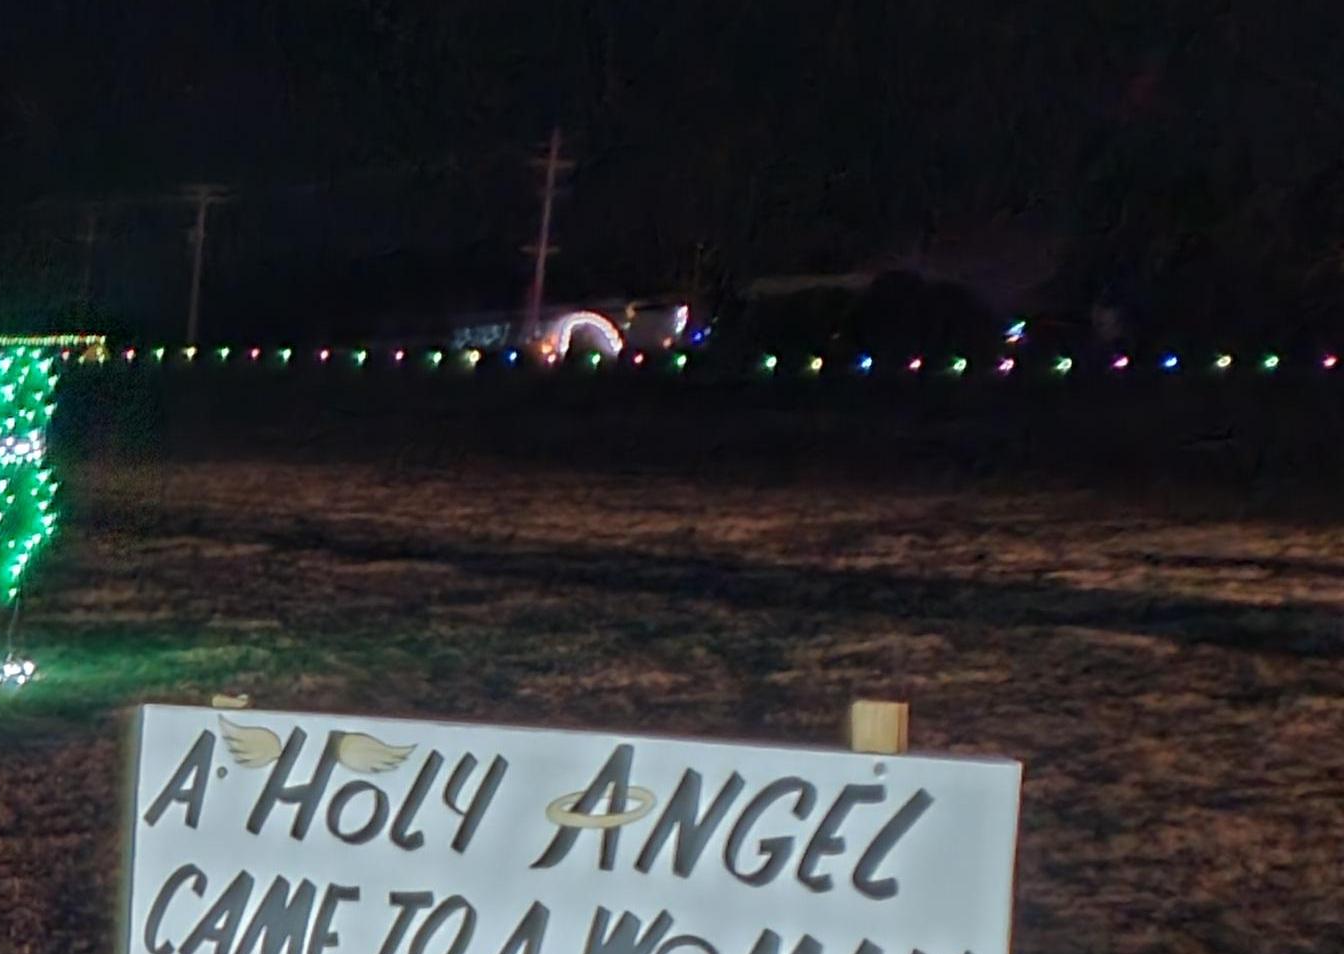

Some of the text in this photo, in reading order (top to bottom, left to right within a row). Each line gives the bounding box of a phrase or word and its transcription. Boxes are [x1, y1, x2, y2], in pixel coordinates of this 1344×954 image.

[144, 726, 935, 900] A HOLY ANGEL
